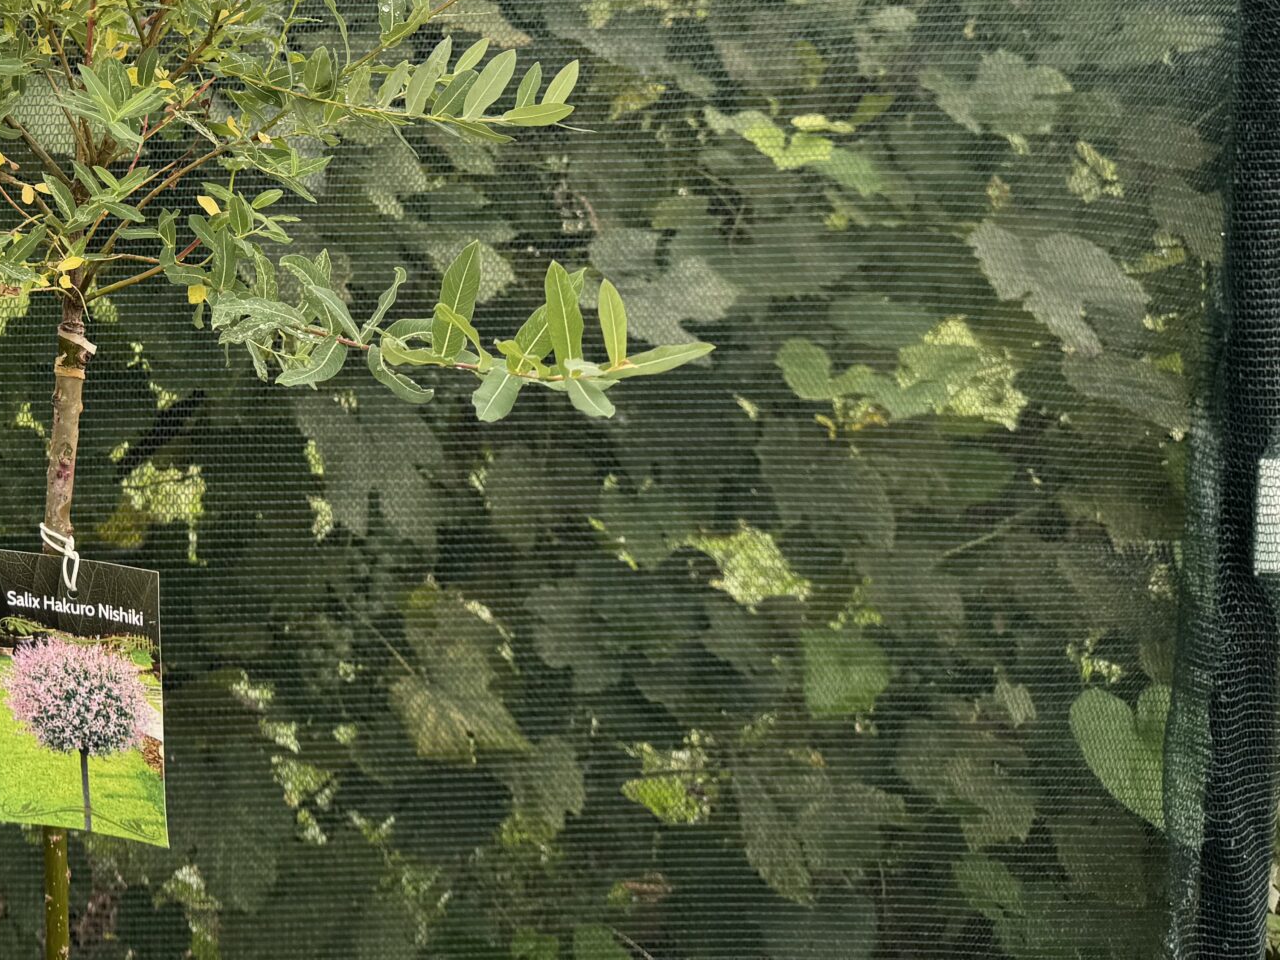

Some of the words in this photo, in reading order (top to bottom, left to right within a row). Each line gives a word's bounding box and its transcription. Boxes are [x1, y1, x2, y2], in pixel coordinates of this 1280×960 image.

[6, 590, 40, 609] Salix
[43, 595, 95, 617] Hakuro
[98, 603, 144, 626] Nishiki
